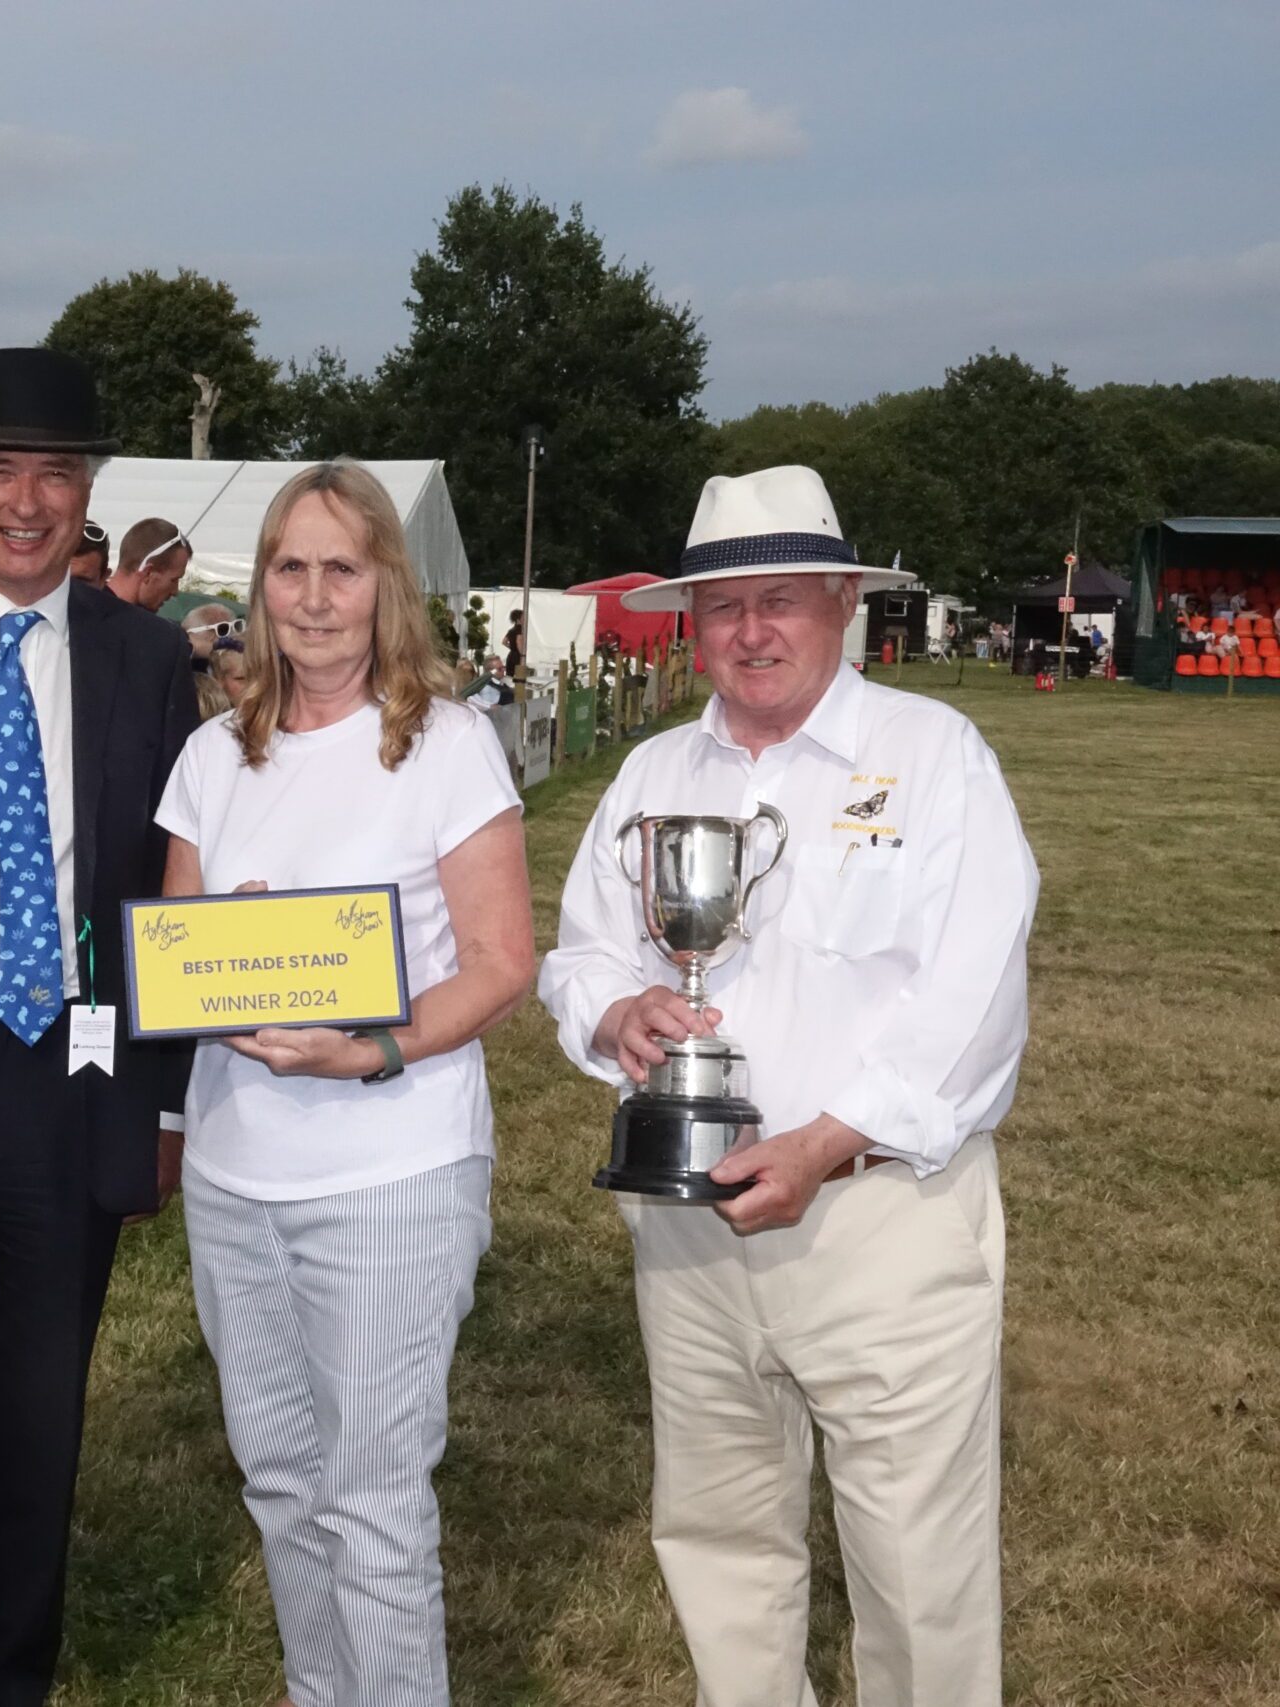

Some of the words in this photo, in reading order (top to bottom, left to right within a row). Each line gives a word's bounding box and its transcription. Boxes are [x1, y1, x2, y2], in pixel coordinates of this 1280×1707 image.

[183, 960, 224, 975] BEST
[229, 956, 284, 972] TRADE
[289, 952, 348, 968] STAND
[200, 993, 281, 1013] WINNER
[287, 989, 338, 1007] 2024
